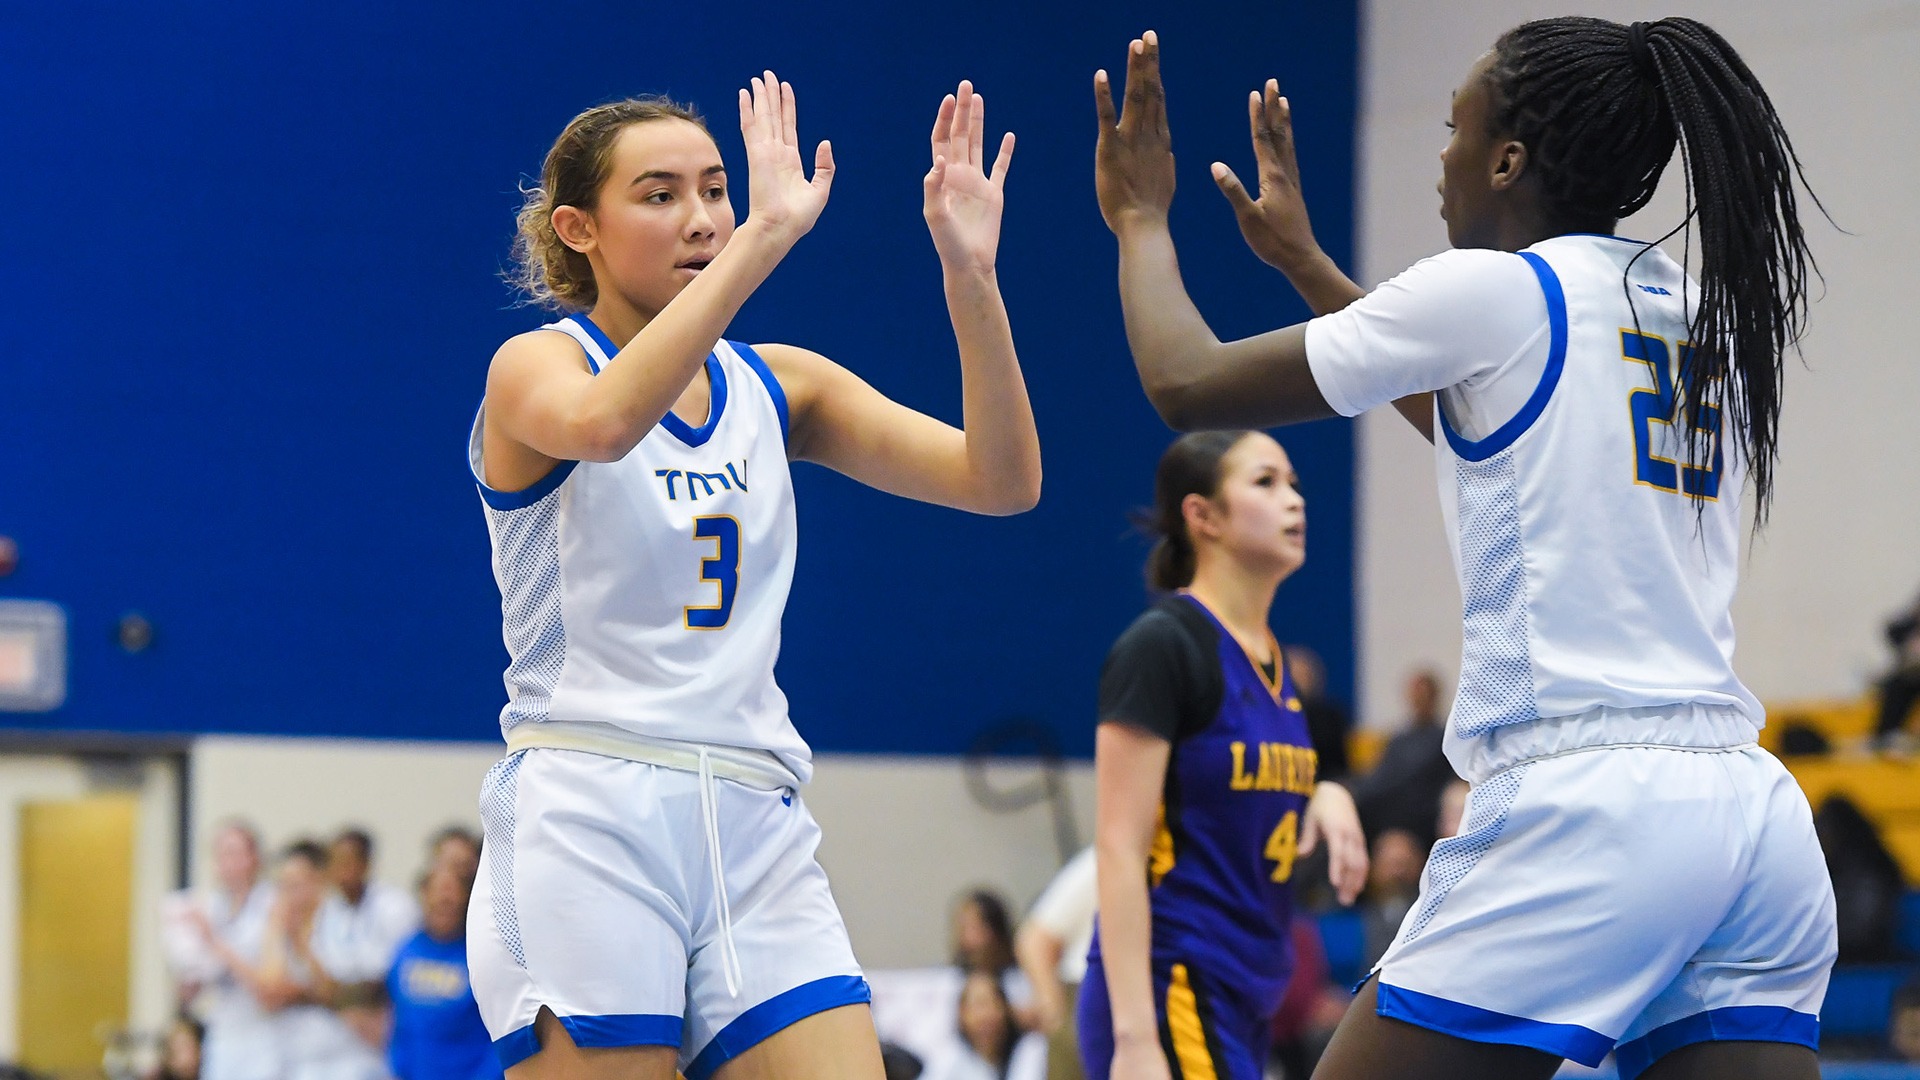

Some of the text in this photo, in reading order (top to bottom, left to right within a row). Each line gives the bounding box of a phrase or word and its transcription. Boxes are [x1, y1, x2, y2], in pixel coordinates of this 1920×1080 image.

[1618, 327, 1725, 502] 25
[654, 459, 748, 501] TMU
[683, 513, 742, 630] 3
